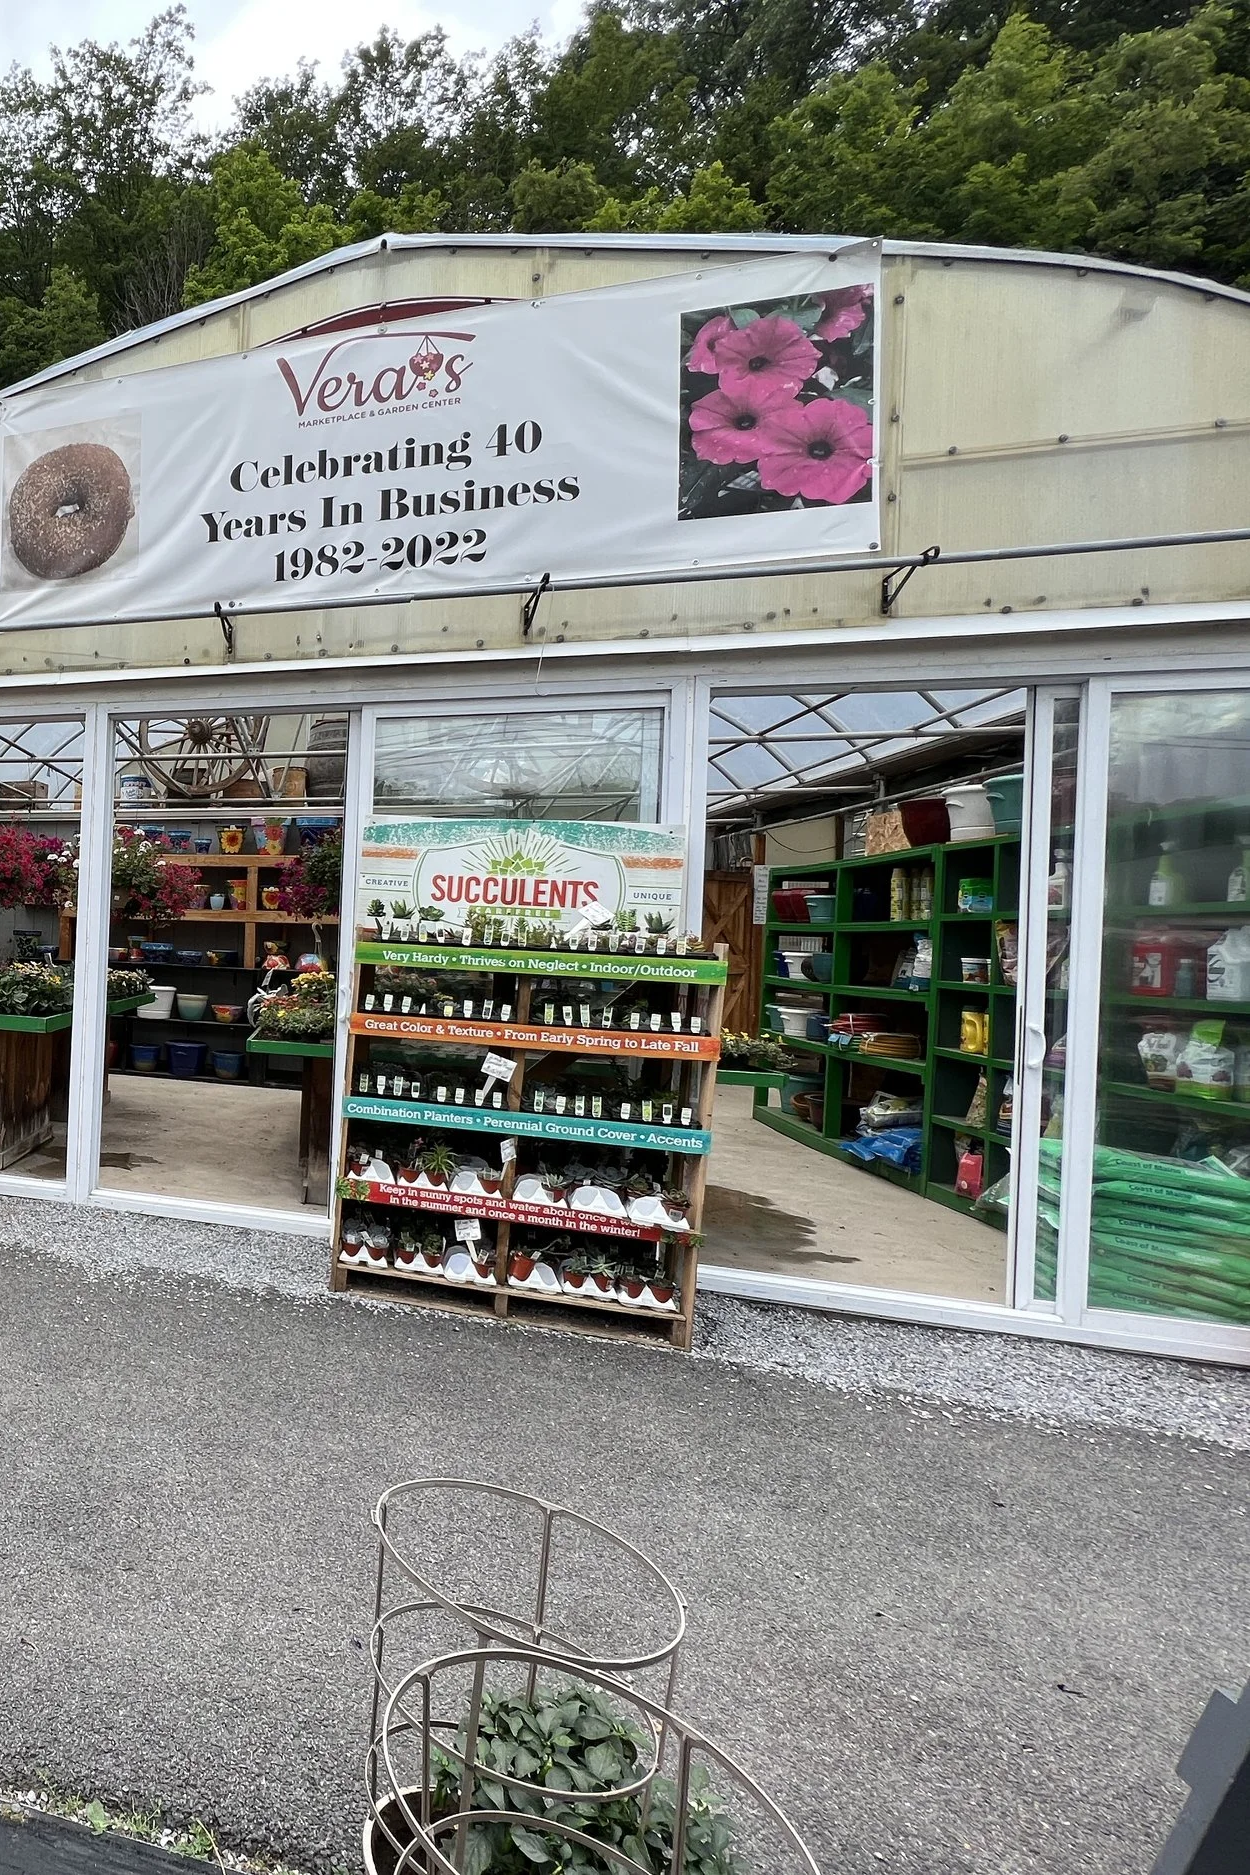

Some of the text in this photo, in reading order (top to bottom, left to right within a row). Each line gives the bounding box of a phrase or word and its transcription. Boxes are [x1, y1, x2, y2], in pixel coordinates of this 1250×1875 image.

[298, 411, 367, 428] MARKETPLACE
[377, 403, 419, 416] GARDEN
[421, 397, 461, 410] CENTER
[229, 419, 543, 493] Celebrating 40
[200, 475, 581, 544] Years In Business
[274, 528, 488, 583] 1982-2022
[365, 878, 409, 887] CREATIVE
[430, 873, 599, 909] SUCCULENTS
[633, 892, 672, 901] UNIQUE
[383, 950, 698, 978] Very Hardy Thrives on Neglect Indoor/Outdoor
[364, 1019, 700, 1053] Great Color & Texture From Early Spring to Late Fall
[347, 1103, 703, 1149] Combination Planters Perennial Ground Cover Accents
[1115, 1158, 1141, 1169] Coast
[379, 1183, 406, 1196] Keep
[408, 1187, 418, 1197] in
[419, 1189, 452, 1202] sunny
[453, 1193, 483, 1206] spots
[485, 1196, 507, 1208] and
[508, 1202, 541, 1213] water
[543, 1205, 577, 1219] about
[578, 1212, 607, 1223] once
[609, 1217, 618, 1225] a
[1128, 1184, 1153, 1193] Coast
[389, 1195, 641, 1238] in the summer and once a month in the winter!
